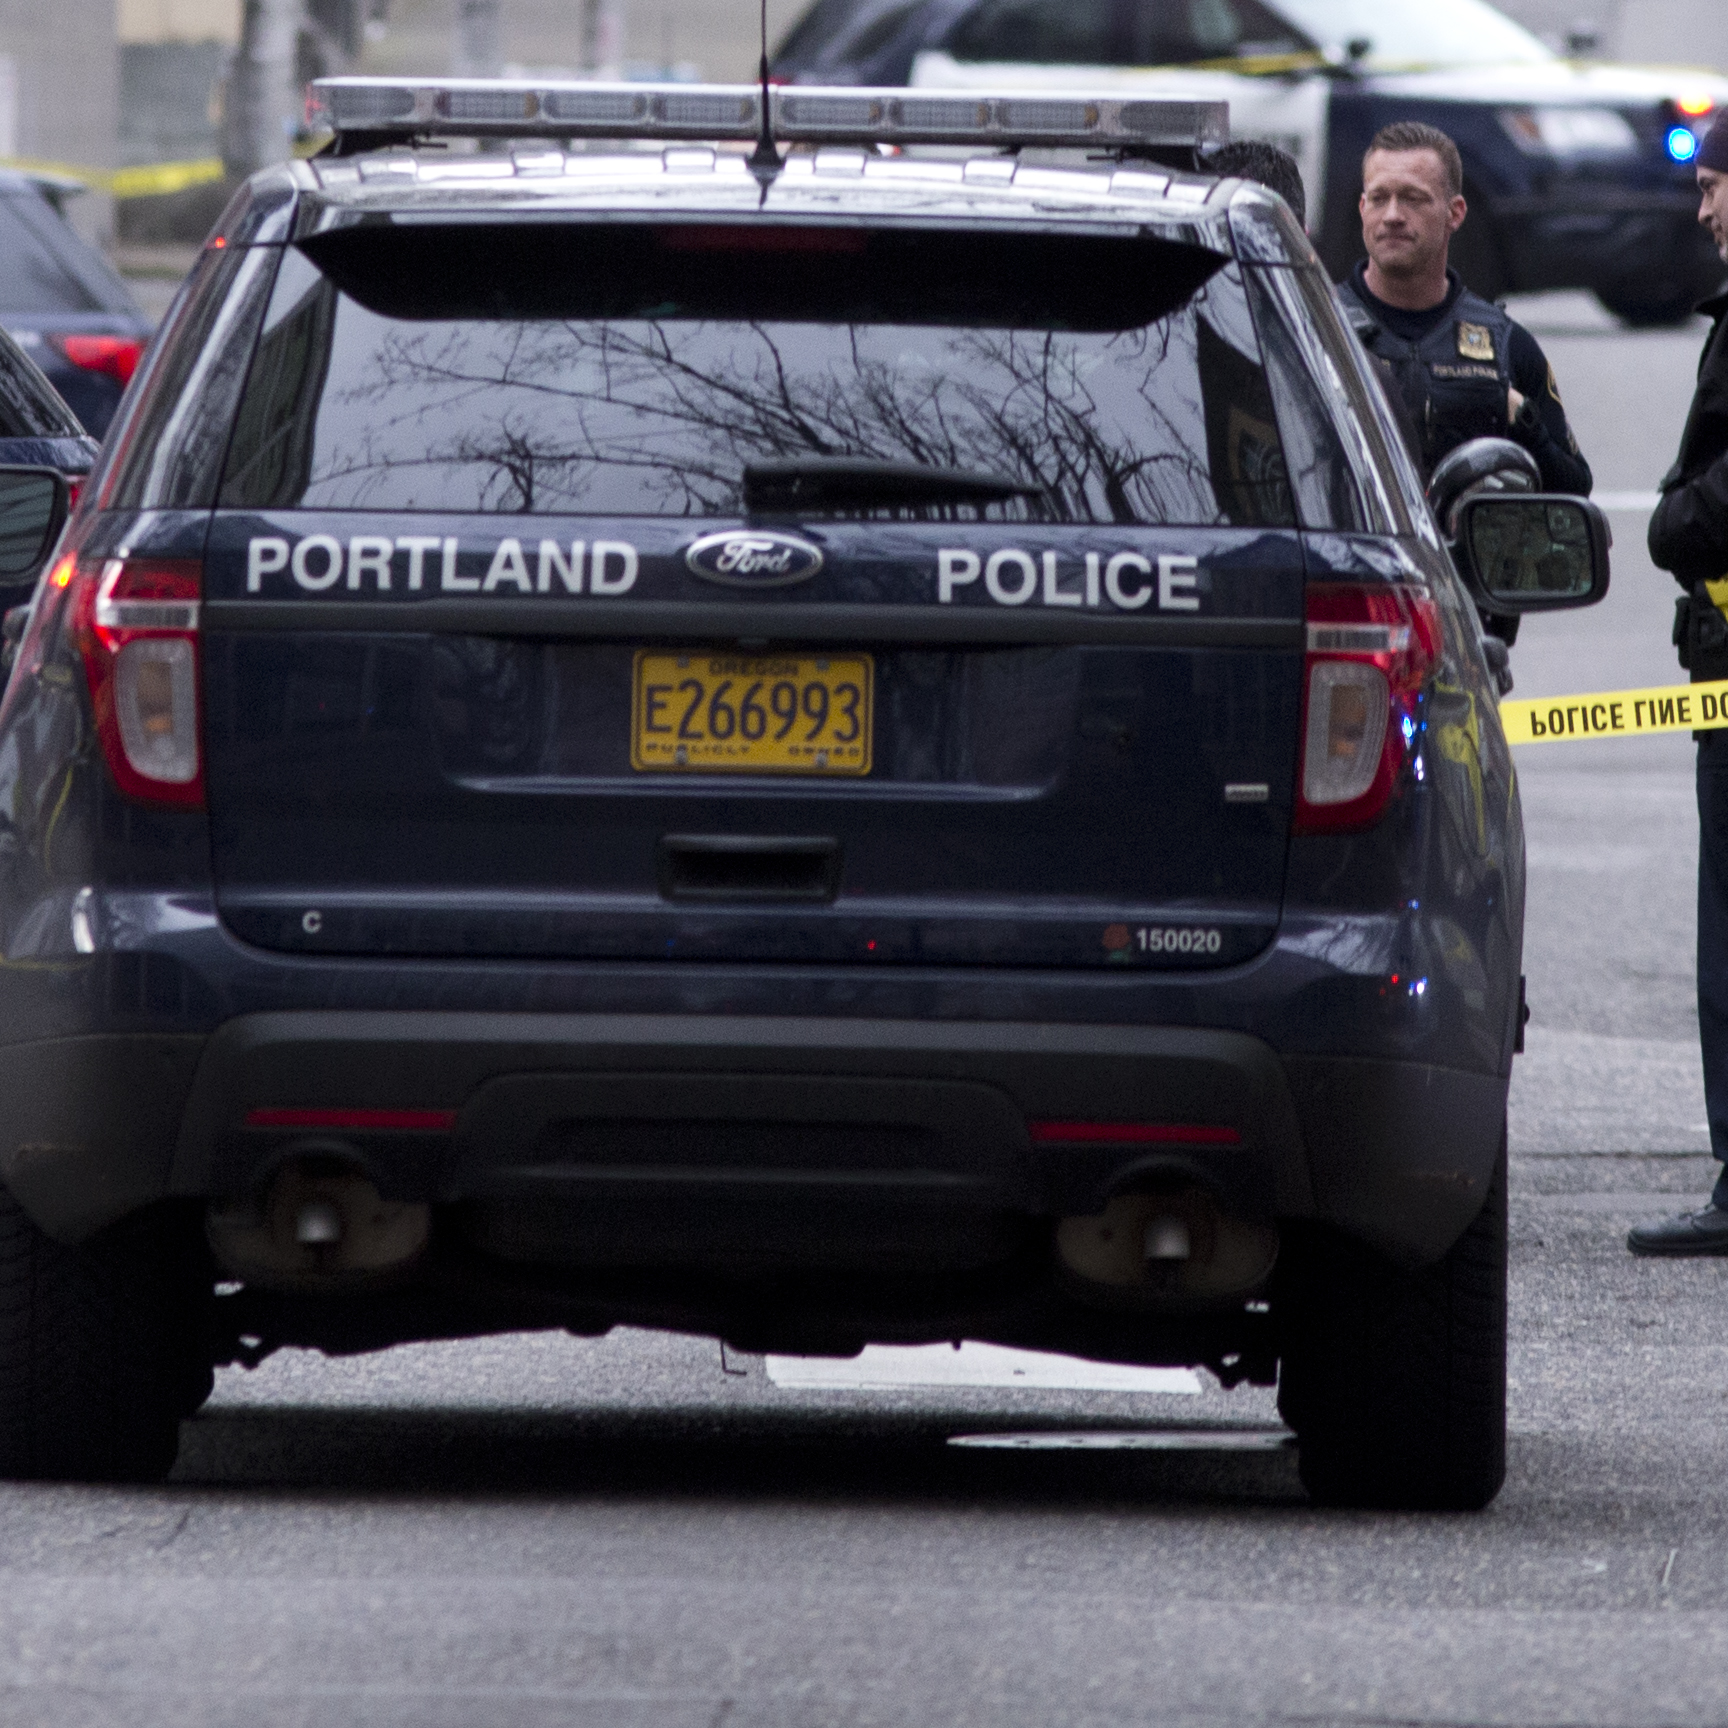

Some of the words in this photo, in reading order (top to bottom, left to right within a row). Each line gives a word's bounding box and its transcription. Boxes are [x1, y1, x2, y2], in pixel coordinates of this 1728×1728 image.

[246, 533, 640, 595] PORTLAND
[716, 539, 793, 574] Ford
[937, 548, 1201, 611] POLICE
[645, 677, 861, 743] E266993
[302, 910, 322, 934] C
[1135, 927, 1222, 954] 150020
